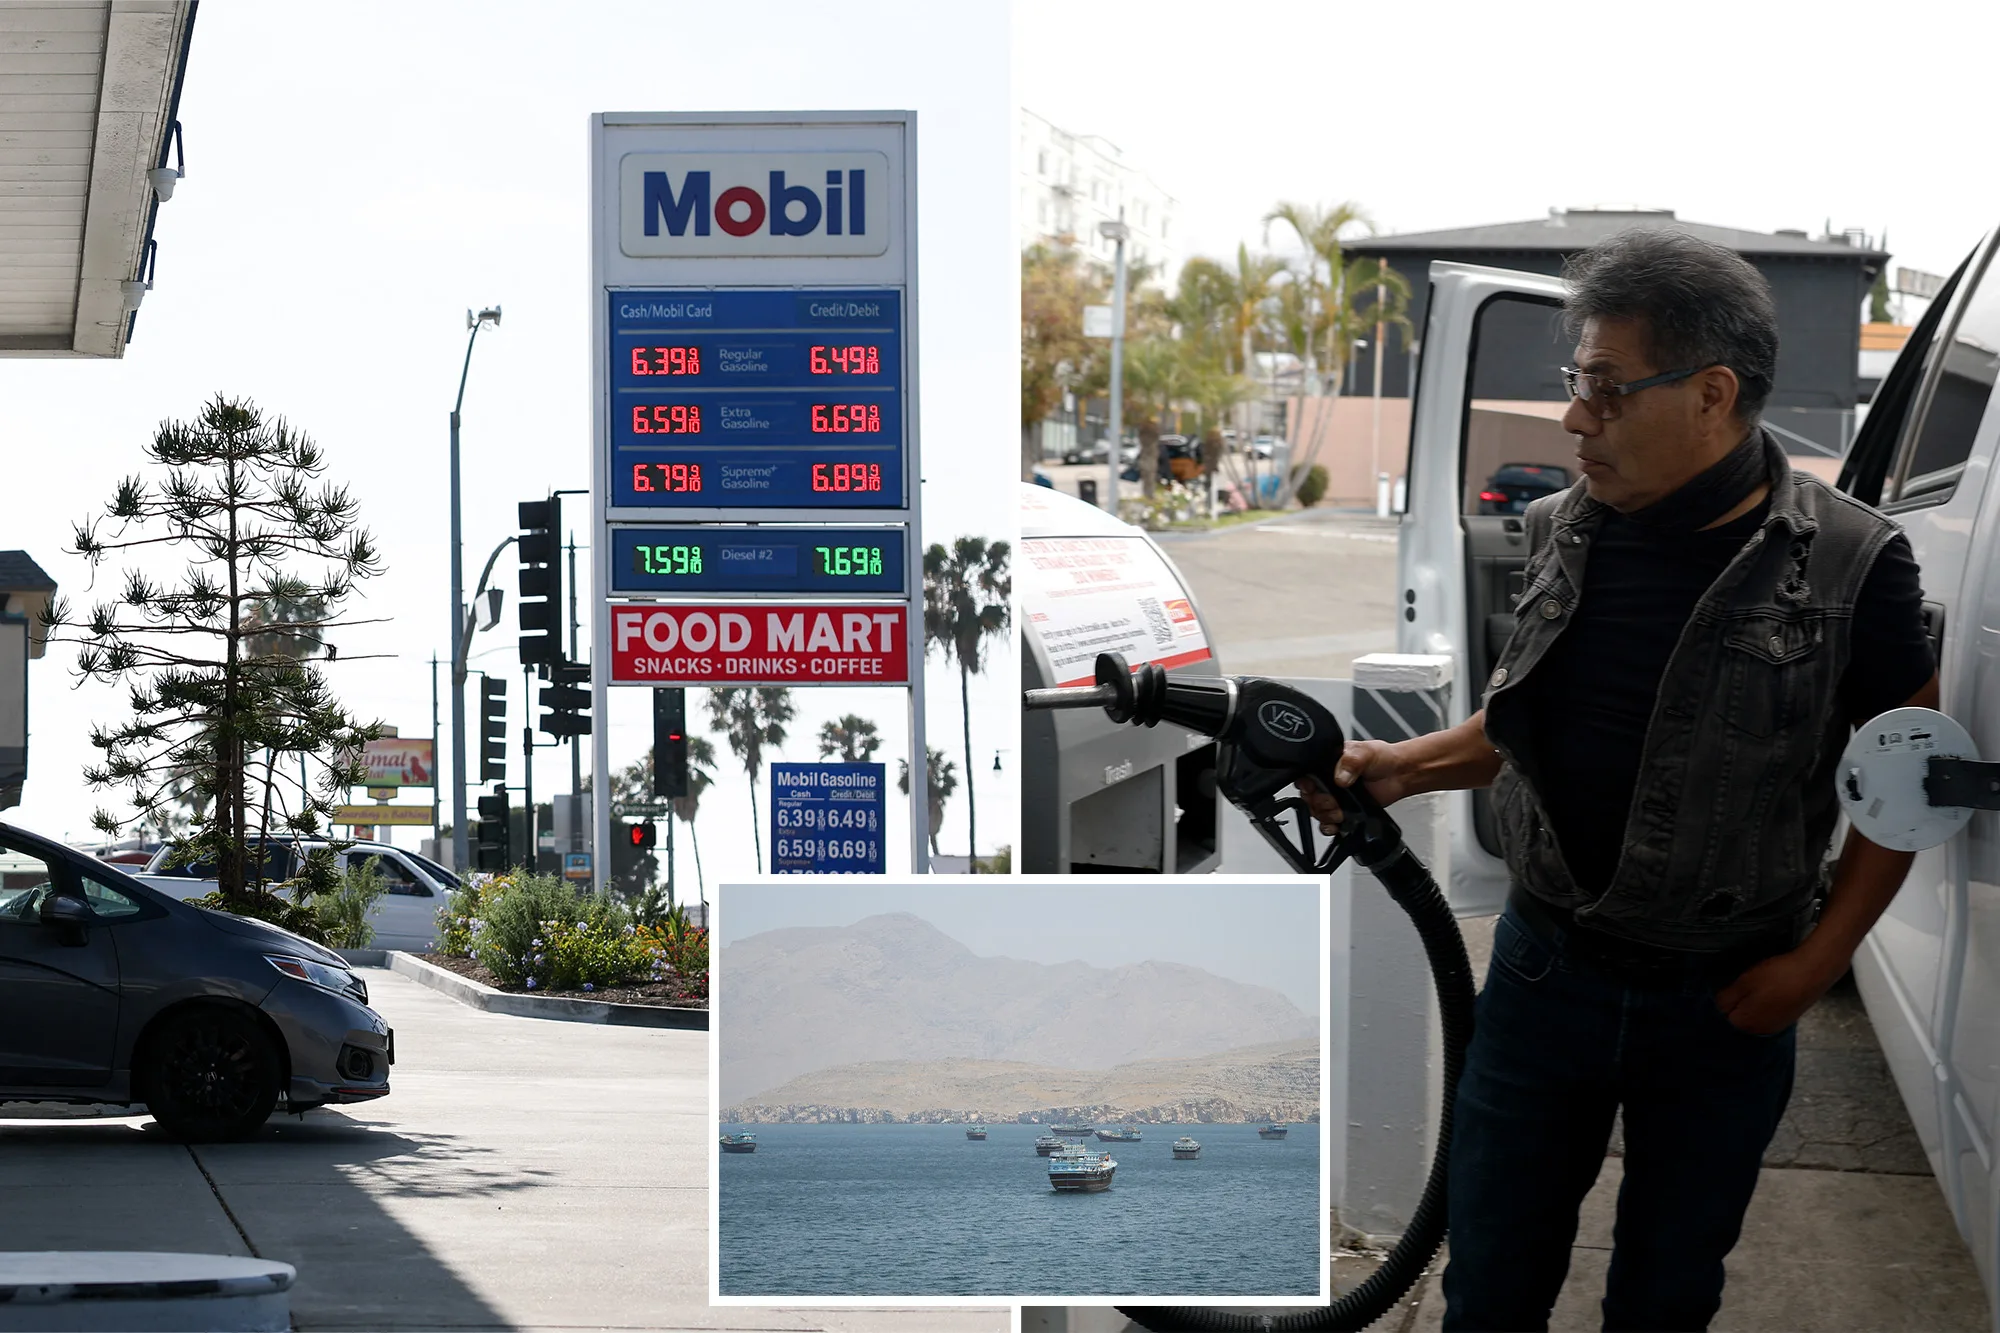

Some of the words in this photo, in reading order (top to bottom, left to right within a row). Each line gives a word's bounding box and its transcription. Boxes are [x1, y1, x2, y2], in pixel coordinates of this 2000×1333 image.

[643, 168, 865, 237] Mobil
[620, 304, 684, 319] Cash/Mobil
[686, 304, 712, 318] Card
[810, 303, 880, 317] Credit/Debit
[632, 347, 686, 375] 6.39
[719, 348, 763, 362] Regular
[810, 346, 865, 374] 6.49
[720, 361, 768, 372] Gasoline
[633, 405, 687, 433] 6.59
[721, 406, 751, 418] Extra
[811, 405, 867, 432] 6.69
[721, 418, 770, 430] Gasoline
[633, 464, 688, 492] 6.79
[721, 478, 770, 489] Gasoline
[812, 463, 867, 492] 6.89
[636, 546, 689, 574] 7.59
[721, 549, 756, 561] Diesel
[758, 549, 773, 561] #2
[815, 547, 868, 575] 7.69
[616, 612, 752, 653] FOOD
[767, 612, 899, 653] MART
[634, 657, 712, 674] SNACKS
[725, 657, 798, 675] DRINKS
[811, 658, 883, 675] COFFEE
[777, 771, 818, 787] Mobil
[820, 771, 877, 788] Gasoline
[791, 790, 811, 799] Cash
[831, 790, 875, 799] Credit/Debit
[779, 800, 802, 808] Regular
[777, 809, 816, 827] 6.39
[828, 809, 867, 828] 6.49
[777, 839, 816, 857] 6.59
[828, 840, 867, 858] 6.69
